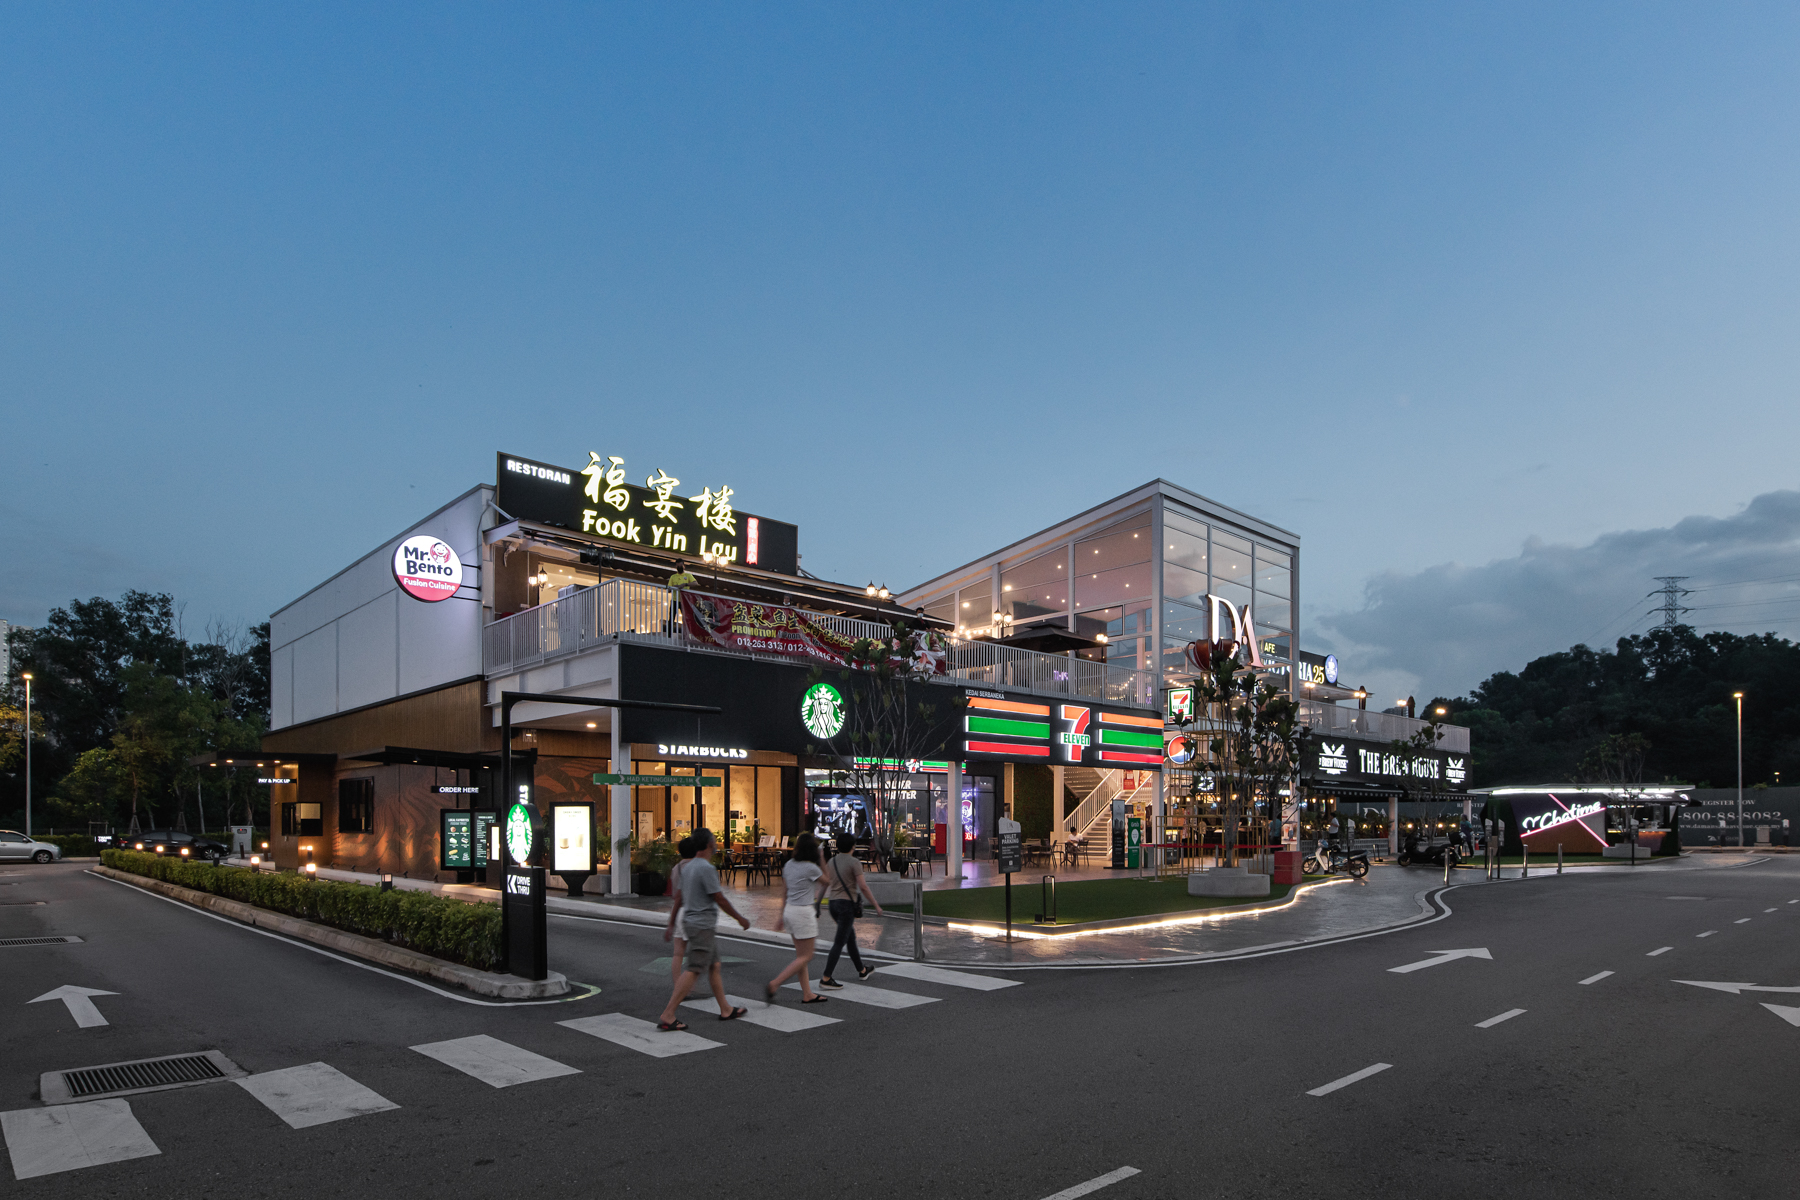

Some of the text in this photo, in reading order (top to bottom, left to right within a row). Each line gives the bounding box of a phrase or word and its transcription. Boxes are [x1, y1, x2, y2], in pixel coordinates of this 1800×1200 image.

[507, 460, 570, 485] RESTORAN
[582, 509, 641, 542] Fook
[651, 524, 687, 552] Yin
[404, 546, 430, 561] Mr.
[406, 560, 453, 576] Bento
[404, 578, 456, 591] Fusion Cuisine
[731, 624, 777, 638] PROMOTION
[1313, 665, 1325, 685] 25
[965, 689, 1005, 699] KEDAI SERBANEKA
[1060, 705, 1091, 762] 7
[658, 744, 748, 759] STARBUCKS
[1358, 749, 1380, 774] THE
[1411, 755, 1440, 779] HOUSE
[1540, 801, 1601, 829] Chatime
[517, 876, 531, 886] DRIVE
[517, 885, 530, 896] THRU
